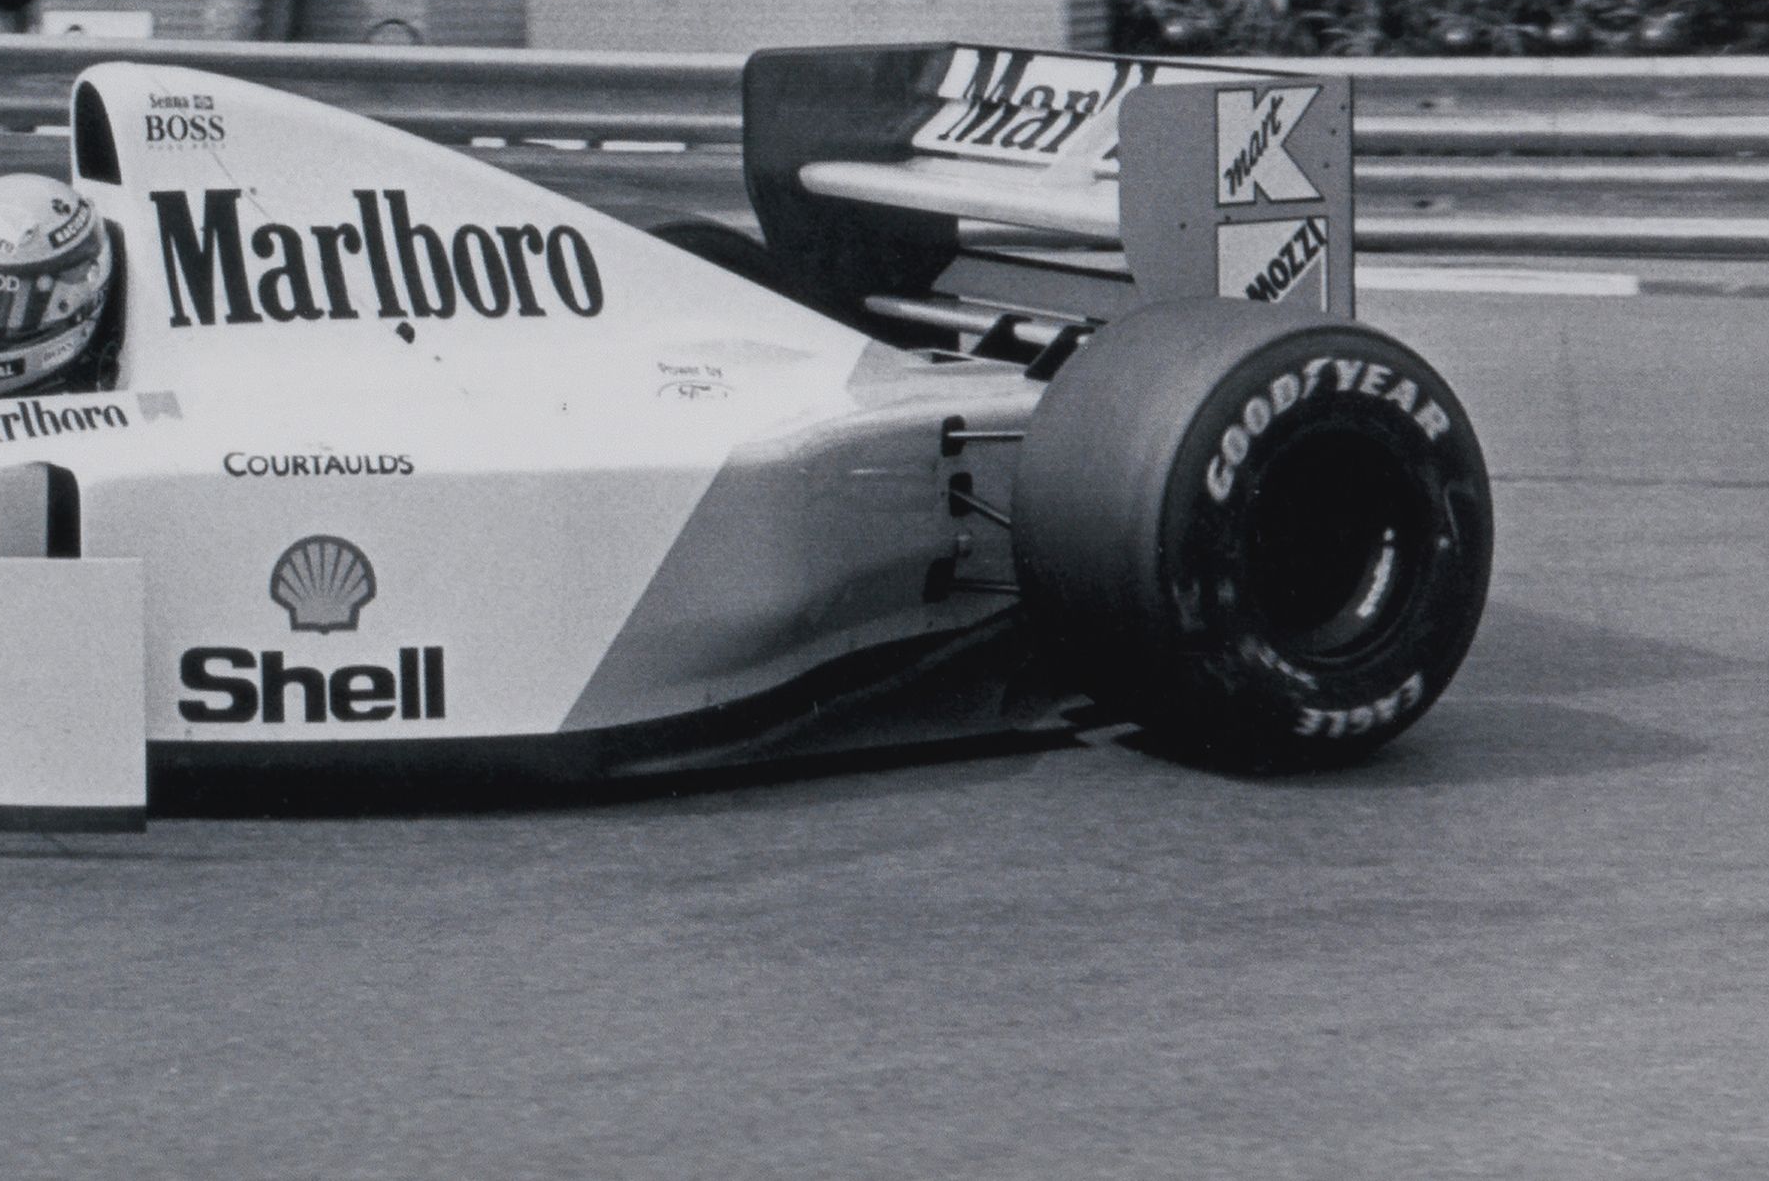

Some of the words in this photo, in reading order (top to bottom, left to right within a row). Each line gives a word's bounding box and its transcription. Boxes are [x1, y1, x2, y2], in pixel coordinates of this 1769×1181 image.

[145, 114, 225, 142] BOSS
[149, 188, 605, 328] Marlboro
[223, 451, 415, 477] COURTAULDS
[1206, 356, 1451, 502] GOODYEAR
[177, 646, 446, 724] Shell
